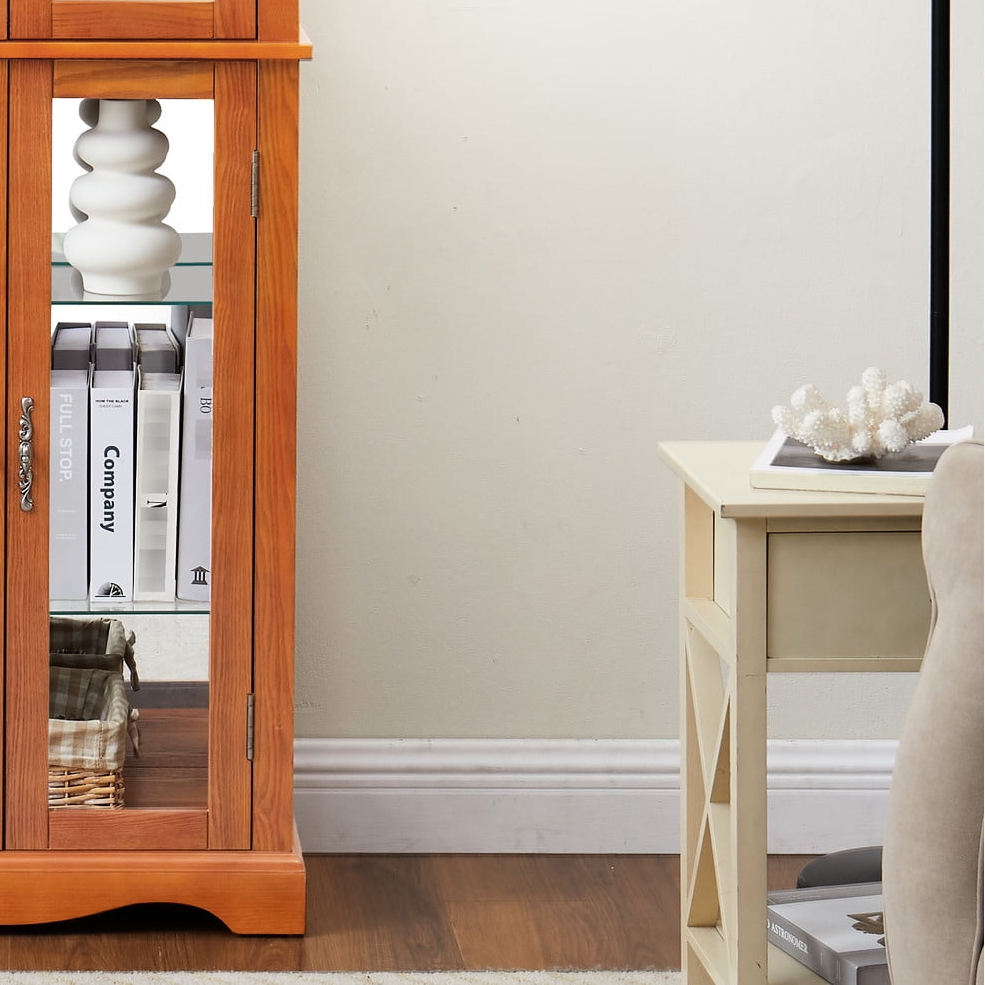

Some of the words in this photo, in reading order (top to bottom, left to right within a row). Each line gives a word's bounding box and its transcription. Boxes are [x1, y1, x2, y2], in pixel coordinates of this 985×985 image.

[59, 394, 73, 434] FULL
[100, 445, 120, 532] Company
[771, 922, 809, 954] ASTRONOMER
